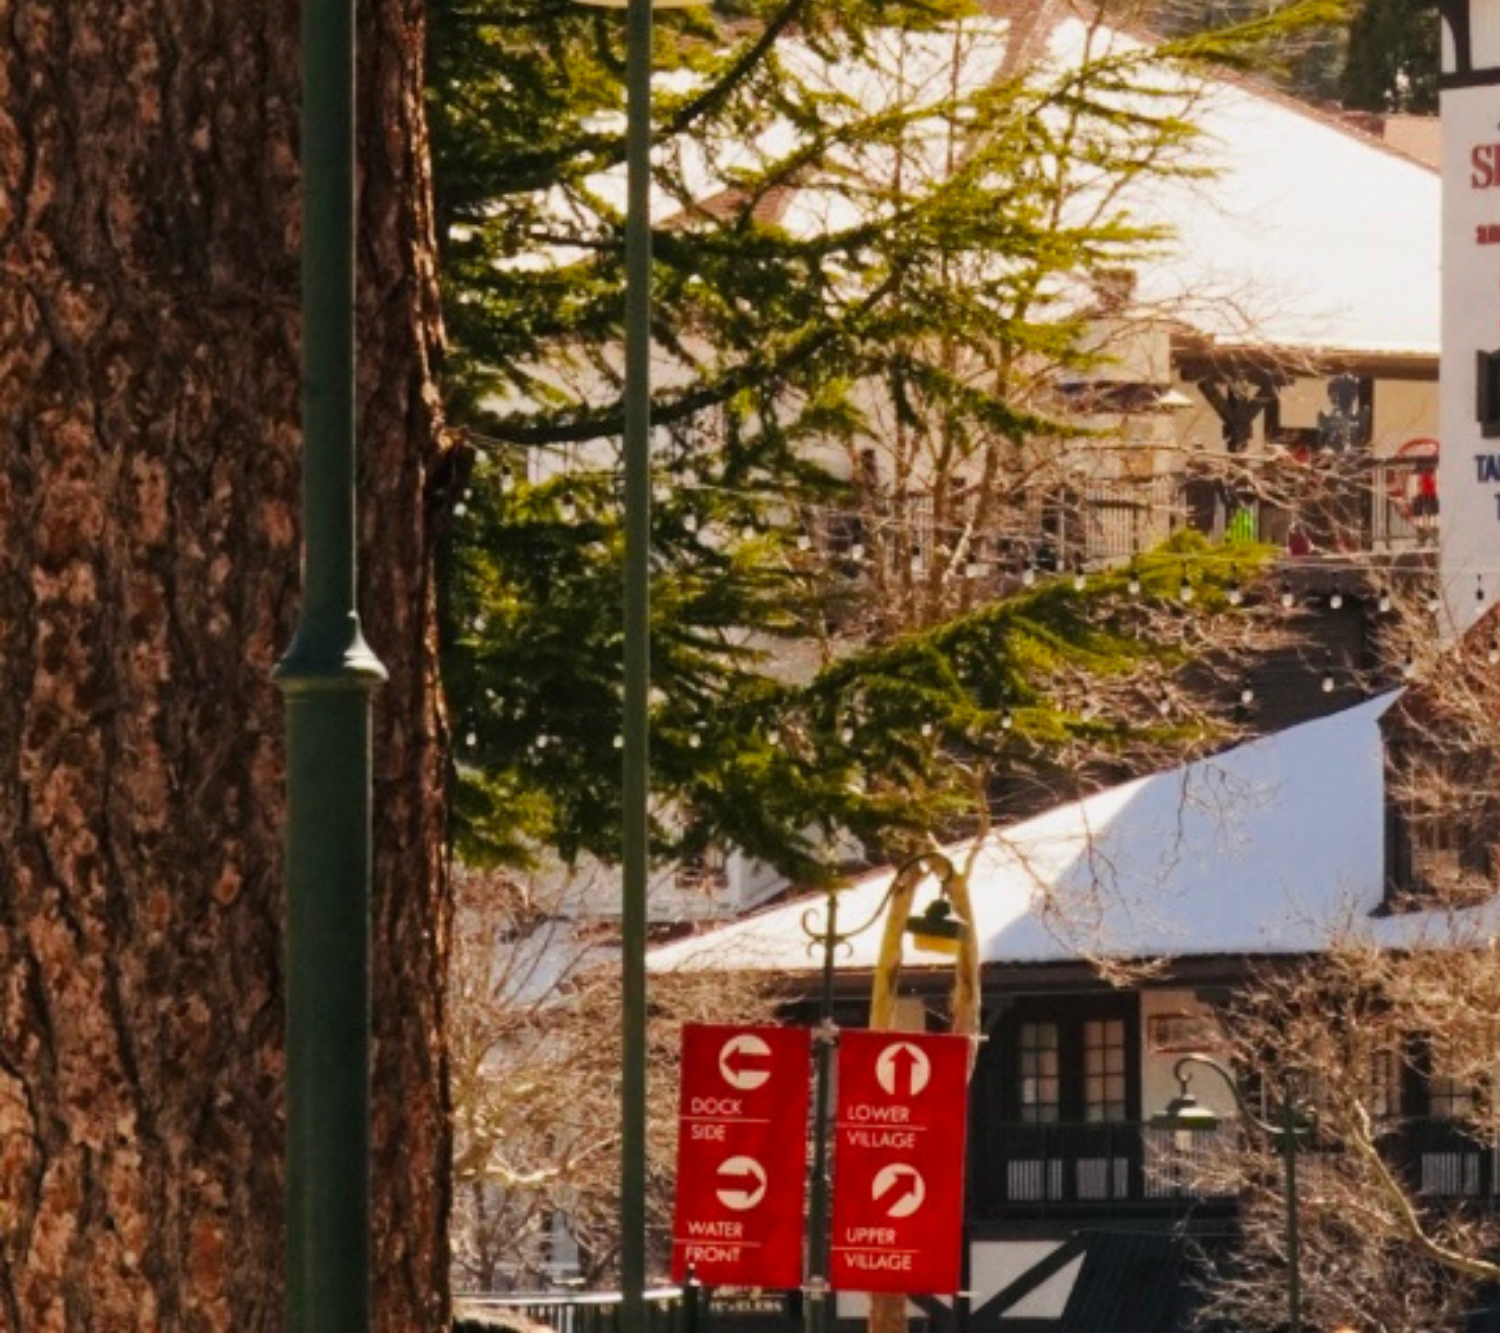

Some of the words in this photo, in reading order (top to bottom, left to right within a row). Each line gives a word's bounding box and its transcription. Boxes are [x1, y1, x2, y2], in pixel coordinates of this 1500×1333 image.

[691, 1098, 742, 1115] DOCK
[847, 1105, 910, 1123] LOWER
[691, 1124, 726, 1141] SIDE
[847, 1130, 915, 1148] VILLAGE
[688, 1221, 743, 1239] WATER
[846, 1227, 896, 1245] UPPER
[685, 1246, 741, 1263] FRONT
[844, 1252, 912, 1271] VILLAGE
